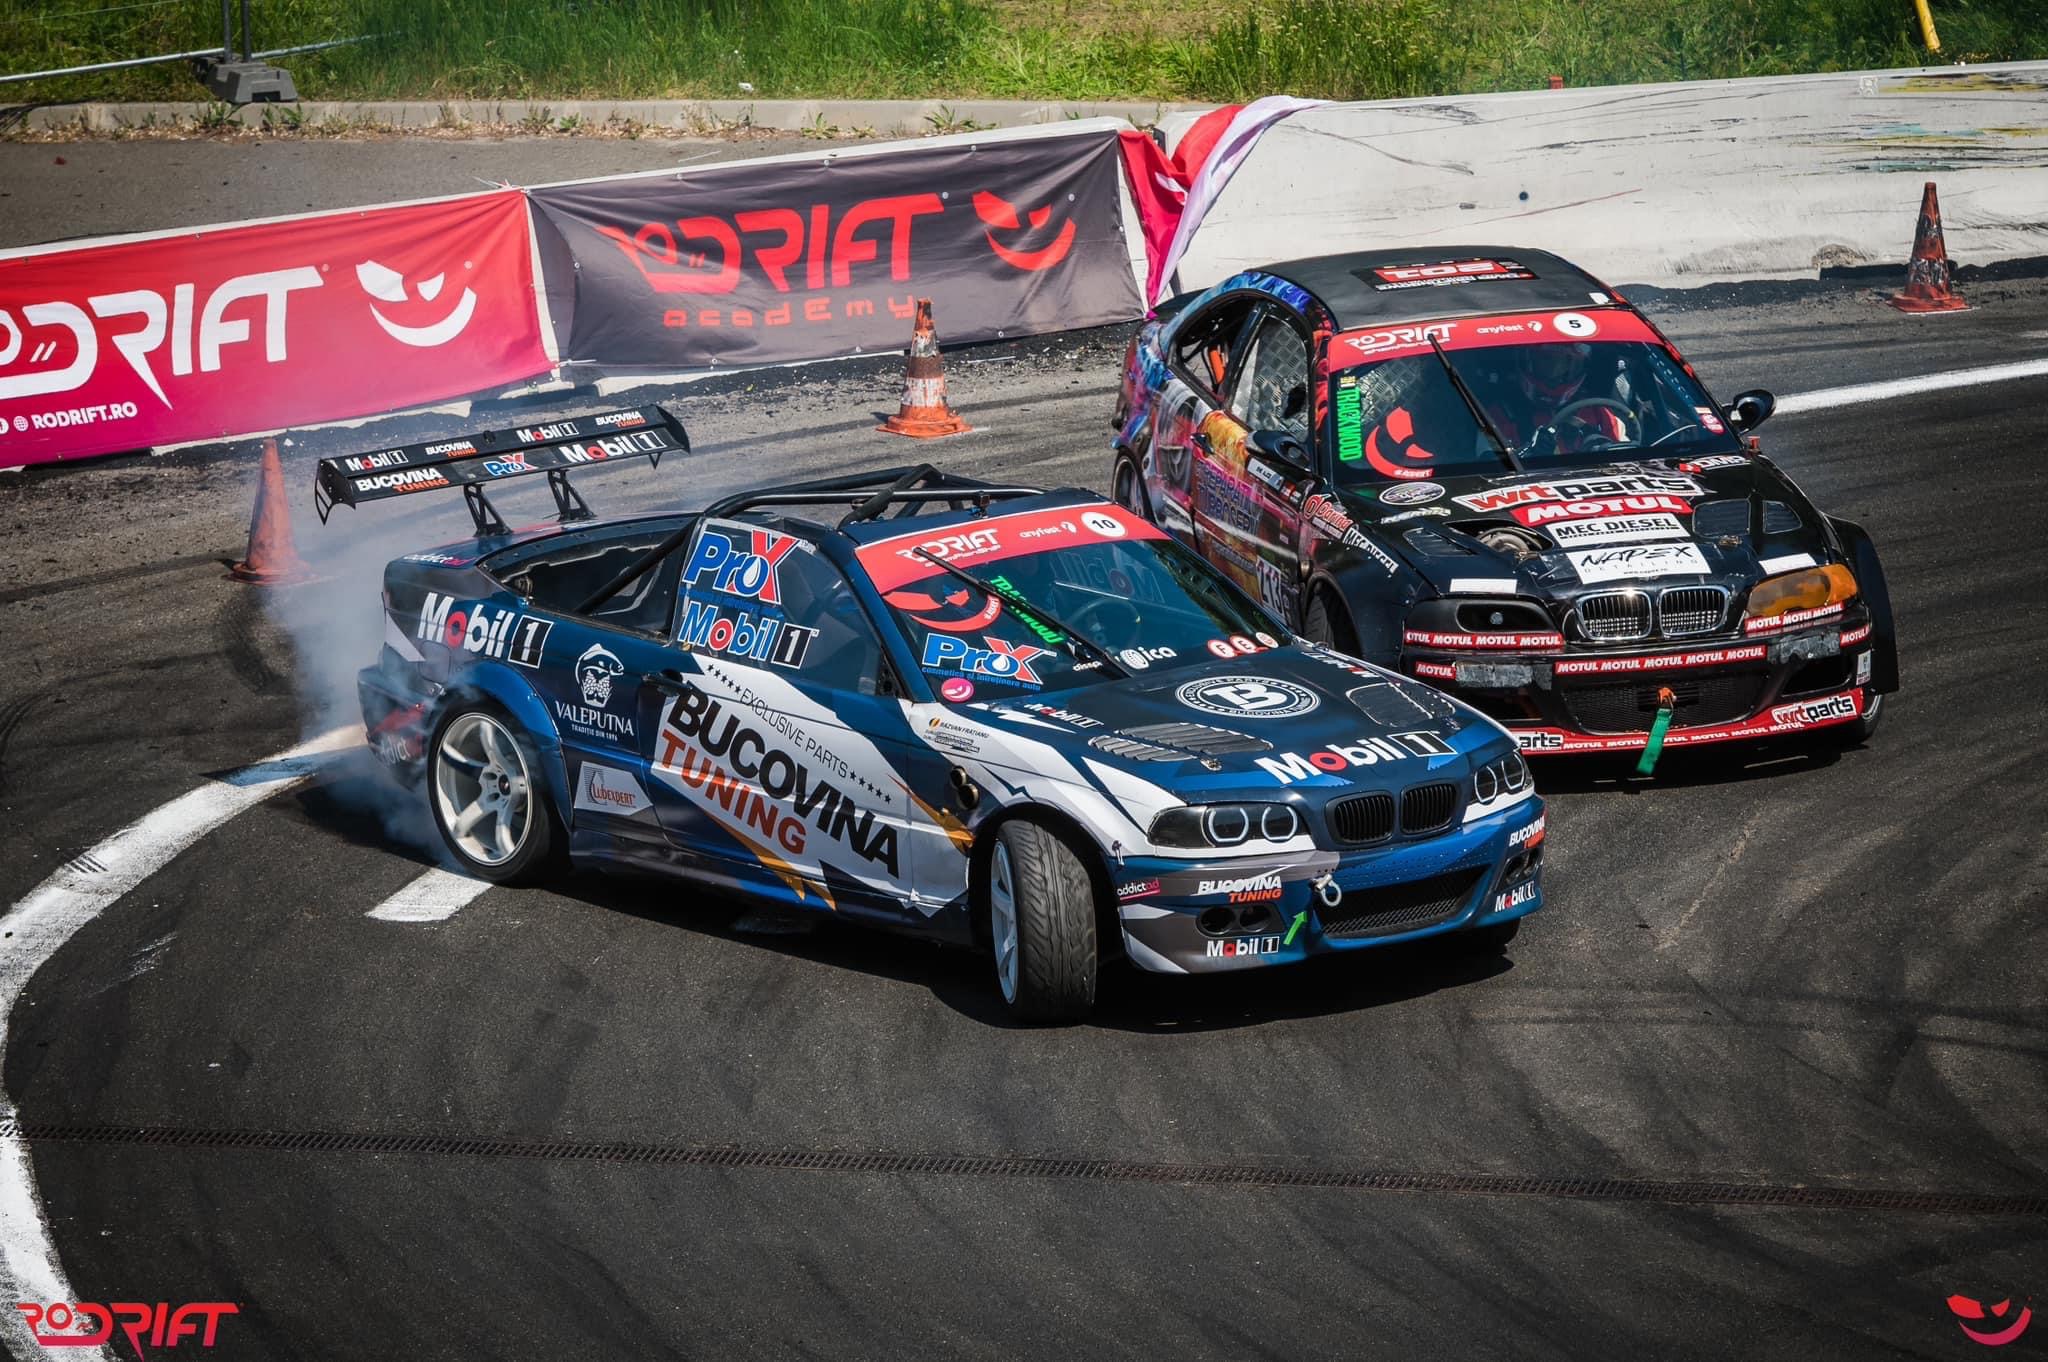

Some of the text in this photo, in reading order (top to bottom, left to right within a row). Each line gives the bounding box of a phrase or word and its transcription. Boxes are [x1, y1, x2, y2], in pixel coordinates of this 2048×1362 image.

[594, 192, 945, 294] RODRIFT
[1569, 318, 1581, 330] 5
[31, 401, 138, 430] RODRIFT.RO
[594, 411, 642, 426] BUCOVINA
[615, 419, 645, 428] TUNING
[1337, 386, 1362, 462] TRACKWOOD
[516, 424, 560, 443] Mobil
[426, 441, 473, 456] BUCOVINA
[445, 448, 477, 457] TUNING
[560, 434, 634, 464] Mobil
[346, 452, 388, 471] Mobil
[355, 469, 443, 492] BUCOVINA
[394, 478, 449, 493] TUNING
[1527, 498, 1682, 524] MOTUL
[1091, 518, 1116, 530] 10
[1555, 523, 1601, 536] MEC
[1604, 518, 1677, 531] DIESEL
[682, 528, 799, 605] ProX
[1812, 605, 1843, 618] MOTUL
[417, 592, 515, 658] Mobil
[678, 600, 779, 663] Mobil
[1747, 615, 1781, 631] MOTUL
[1433, 633, 1472, 645] MOTUL
[1476, 635, 1517, 645] MOTUL
[1520, 636, 1560, 646] MOTUL
[922, 632, 1044, 686] ProX
[1558, 647, 1764, 673] MOTUL MOTUL MOTUL MOTUL MOTUL
[1416, 663, 1453, 677] MOTUL
[555, 700, 634, 737] VALEPUTNA
[740, 688, 848, 777] EXCLUSIVE PARTS
[1607, 740, 1646, 748] MOTUL
[1691, 732, 1728, 741] MOTUL
[1731, 727, 1768, 737] MOTUL
[1770, 722, 1804, 732] MOTUL
[1254, 737, 1407, 785] Mobil
[667, 681, 900, 880] BUCOVINA
[660, 729, 807, 855] TUNING
[1117, 878, 1160, 896] addictad
[1198, 876, 1282, 896] BUCOVINA
[1229, 888, 1283, 903] TUNING
[1495, 886, 1524, 912] Mobil
[1206, 938, 1258, 957] Mobil
